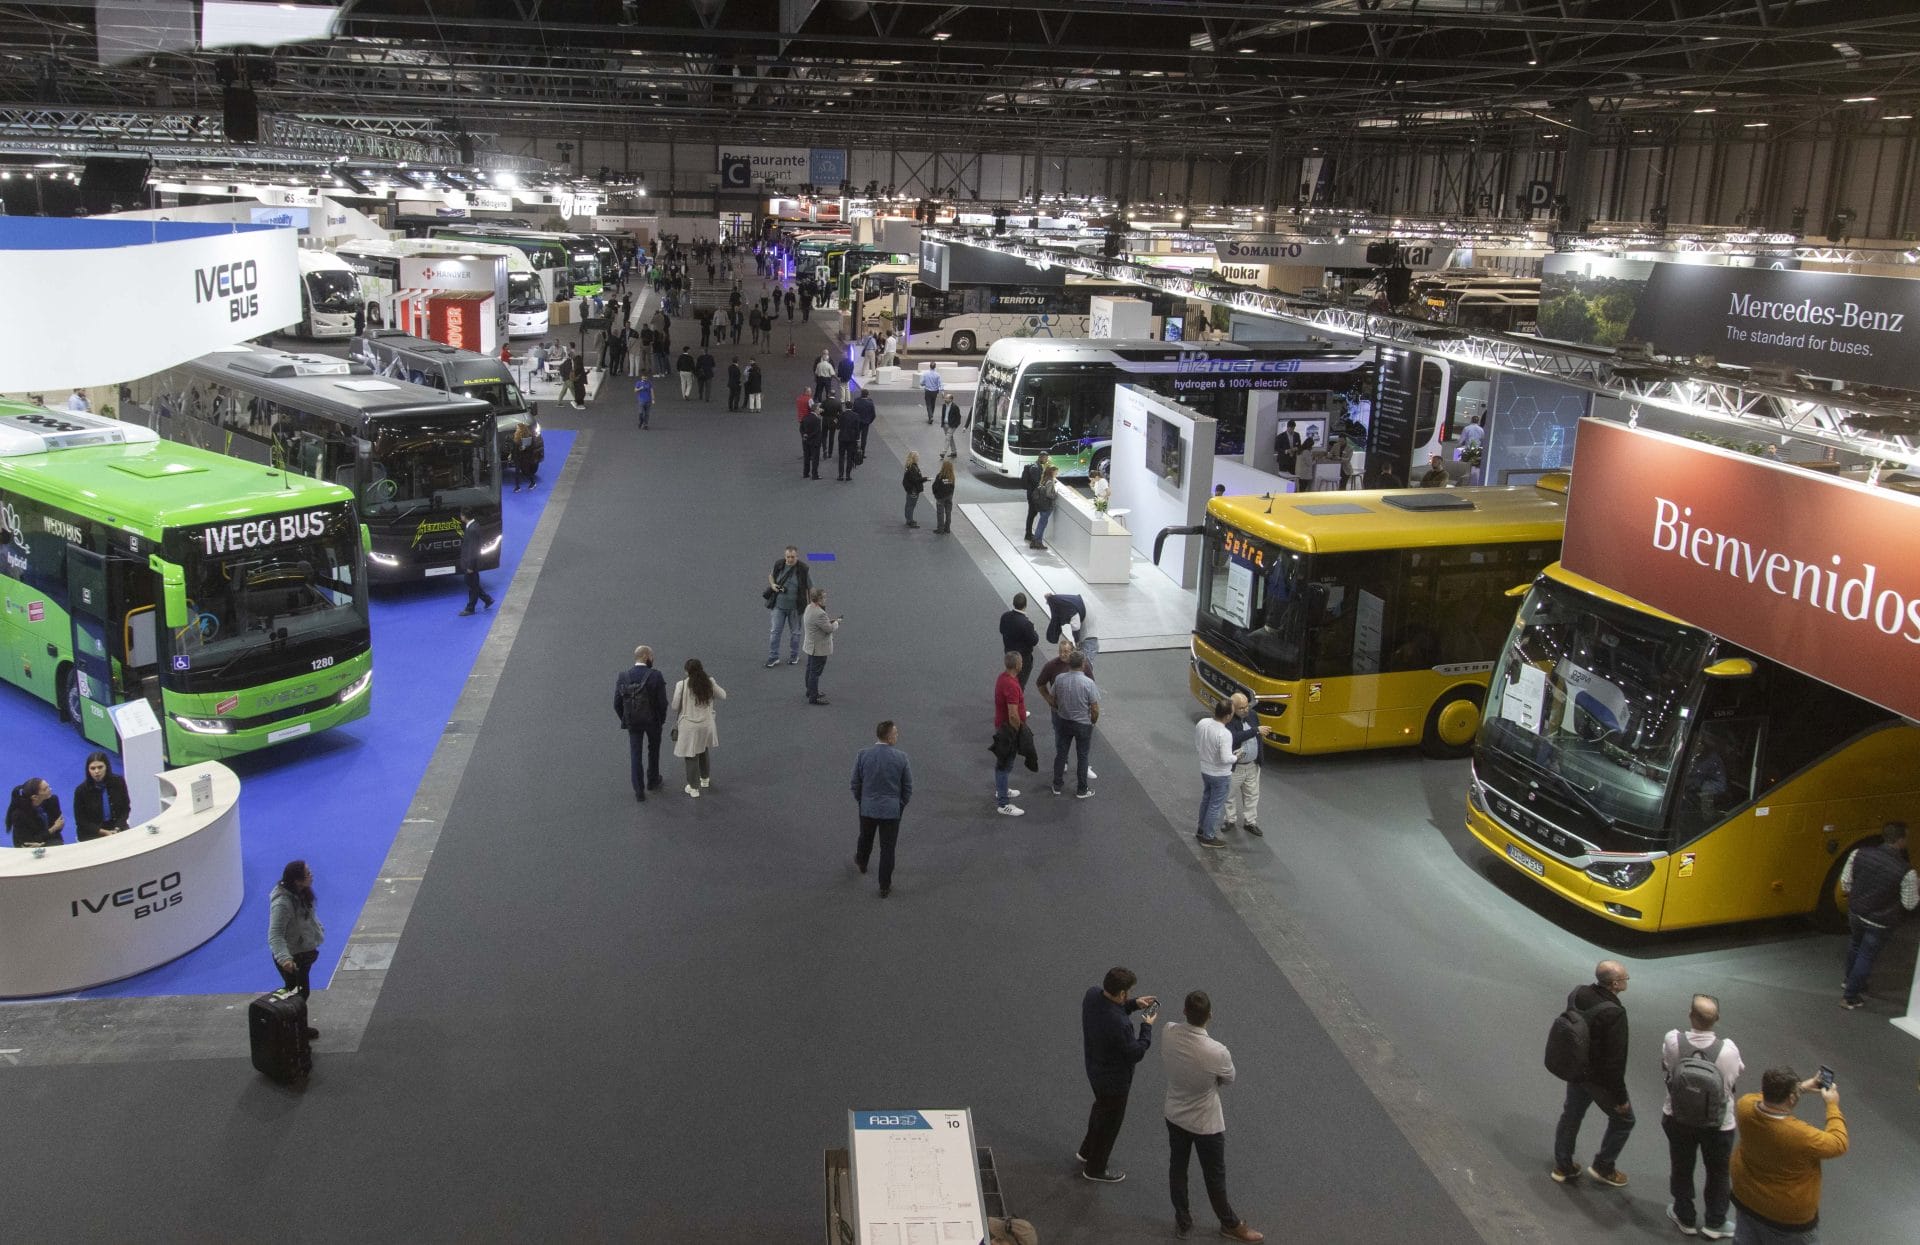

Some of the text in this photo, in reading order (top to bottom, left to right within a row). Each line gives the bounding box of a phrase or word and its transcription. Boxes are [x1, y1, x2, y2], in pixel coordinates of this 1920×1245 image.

[728, 163, 744, 184] C
[1531, 184, 1548, 205] D
[195, 259, 258, 304] IVECO
[436, 270, 471, 279] HANOVER
[1221, 264, 1260, 280] Otokar
[229, 293, 259, 323] BUS
[1037, 296, 1045, 305] U
[1728, 292, 1904, 332] Mercedes-Benz
[1726, 325, 1873, 357] The standard for buses.
[1260, 358, 1302, 373] cell
[1174, 379, 1288, 391] hydrogen & 100% electric
[43, 515, 82, 544] IVECO BUS
[205, 511, 325, 555] IVECO BUS
[418, 539, 462, 552] IVECO
[1224, 531, 1263, 566] Setra
[7, 551, 28, 570] hybrid
[1652, 496, 1920, 645] Bienvenidos
[311, 656, 334, 671] 1280
[257, 683, 320, 709] IVECO
[1496, 800, 1566, 847] SETRA
[71, 872, 181, 917] IVECO
[134, 891, 183, 920] BUS
[946, 1120, 960, 1129] 10
